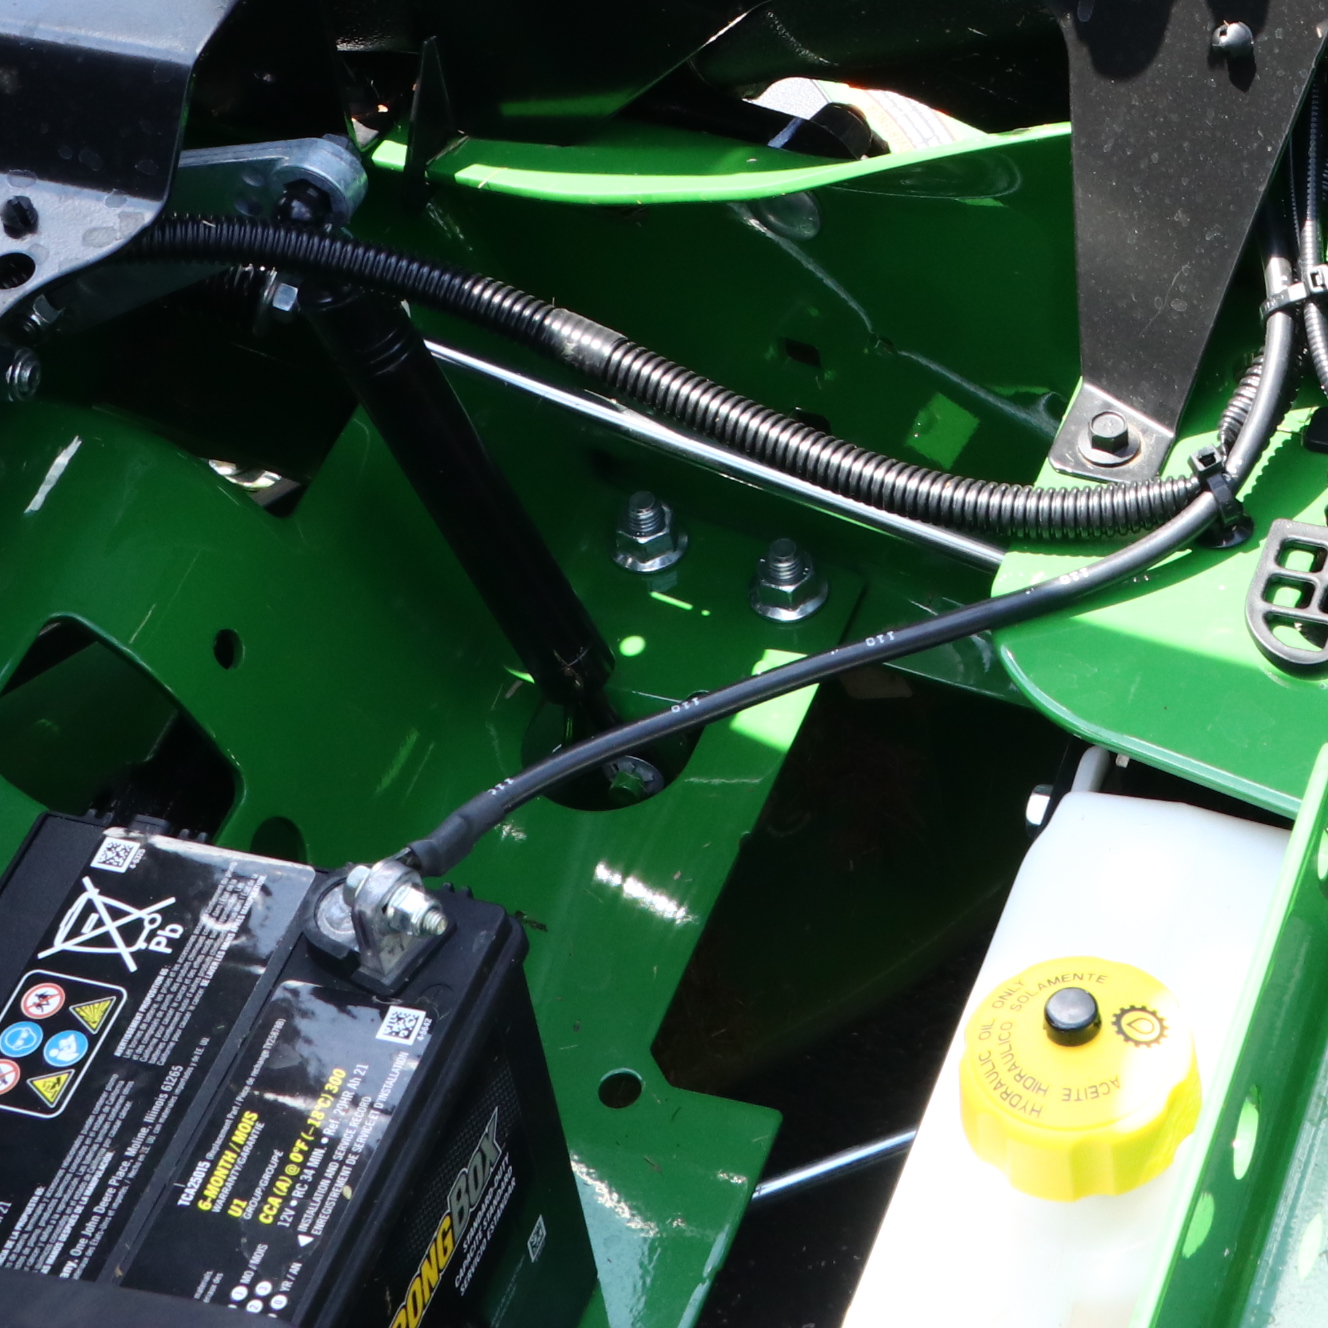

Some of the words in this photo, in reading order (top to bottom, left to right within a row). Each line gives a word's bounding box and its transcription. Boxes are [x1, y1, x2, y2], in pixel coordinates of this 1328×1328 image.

[148, 923, 184, 954] Pb
[992, 979, 1025, 1010] ONLY
[1010, 972, 1109, 1012] SOLAMENTE
[978, 1018, 995, 1041] OIL
[353, 1064, 368, 1076] 21
[998, 1021, 1049, 1097] HIDRAULICO
[346, 1077, 361, 1090] Ah
[978, 1050, 1043, 1119] HYDRAULIC
[1061, 1075, 1121, 1102] ACEITE
[333, 1090, 354, 1115] 20HR
[323, 1118, 341, 1135] Ref.
[70, 1238, 88, 1261] One
[80, 1215, 101, 1237] John
[92, 1187, 116, 1213] Deere
[107, 1158, 134, 1186] Place,
[124, 1125, 152, 1155] Moline,
[143, 1093, 168, 1123] Illinois
[160, 1065, 186, 1091] 61265
[197, 1150, 237, 1211] 6-MONTH
[230, 1111, 258, 1145] MOIS
[211, 1120, 265, 1212] WARRANTY/GARANTIE
[306, 1146, 328, 1168] MIN.
[177, 1160, 210, 1206] TCA25015
[238, 1148, 284, 1219] GROUP/GROUPÉ
[299, 1168, 316, 1182] 34
[292, 1182, 308, 1198] RC
[227, 1199, 247, 1217] U1
[276, 1207, 295, 1227] 12V
